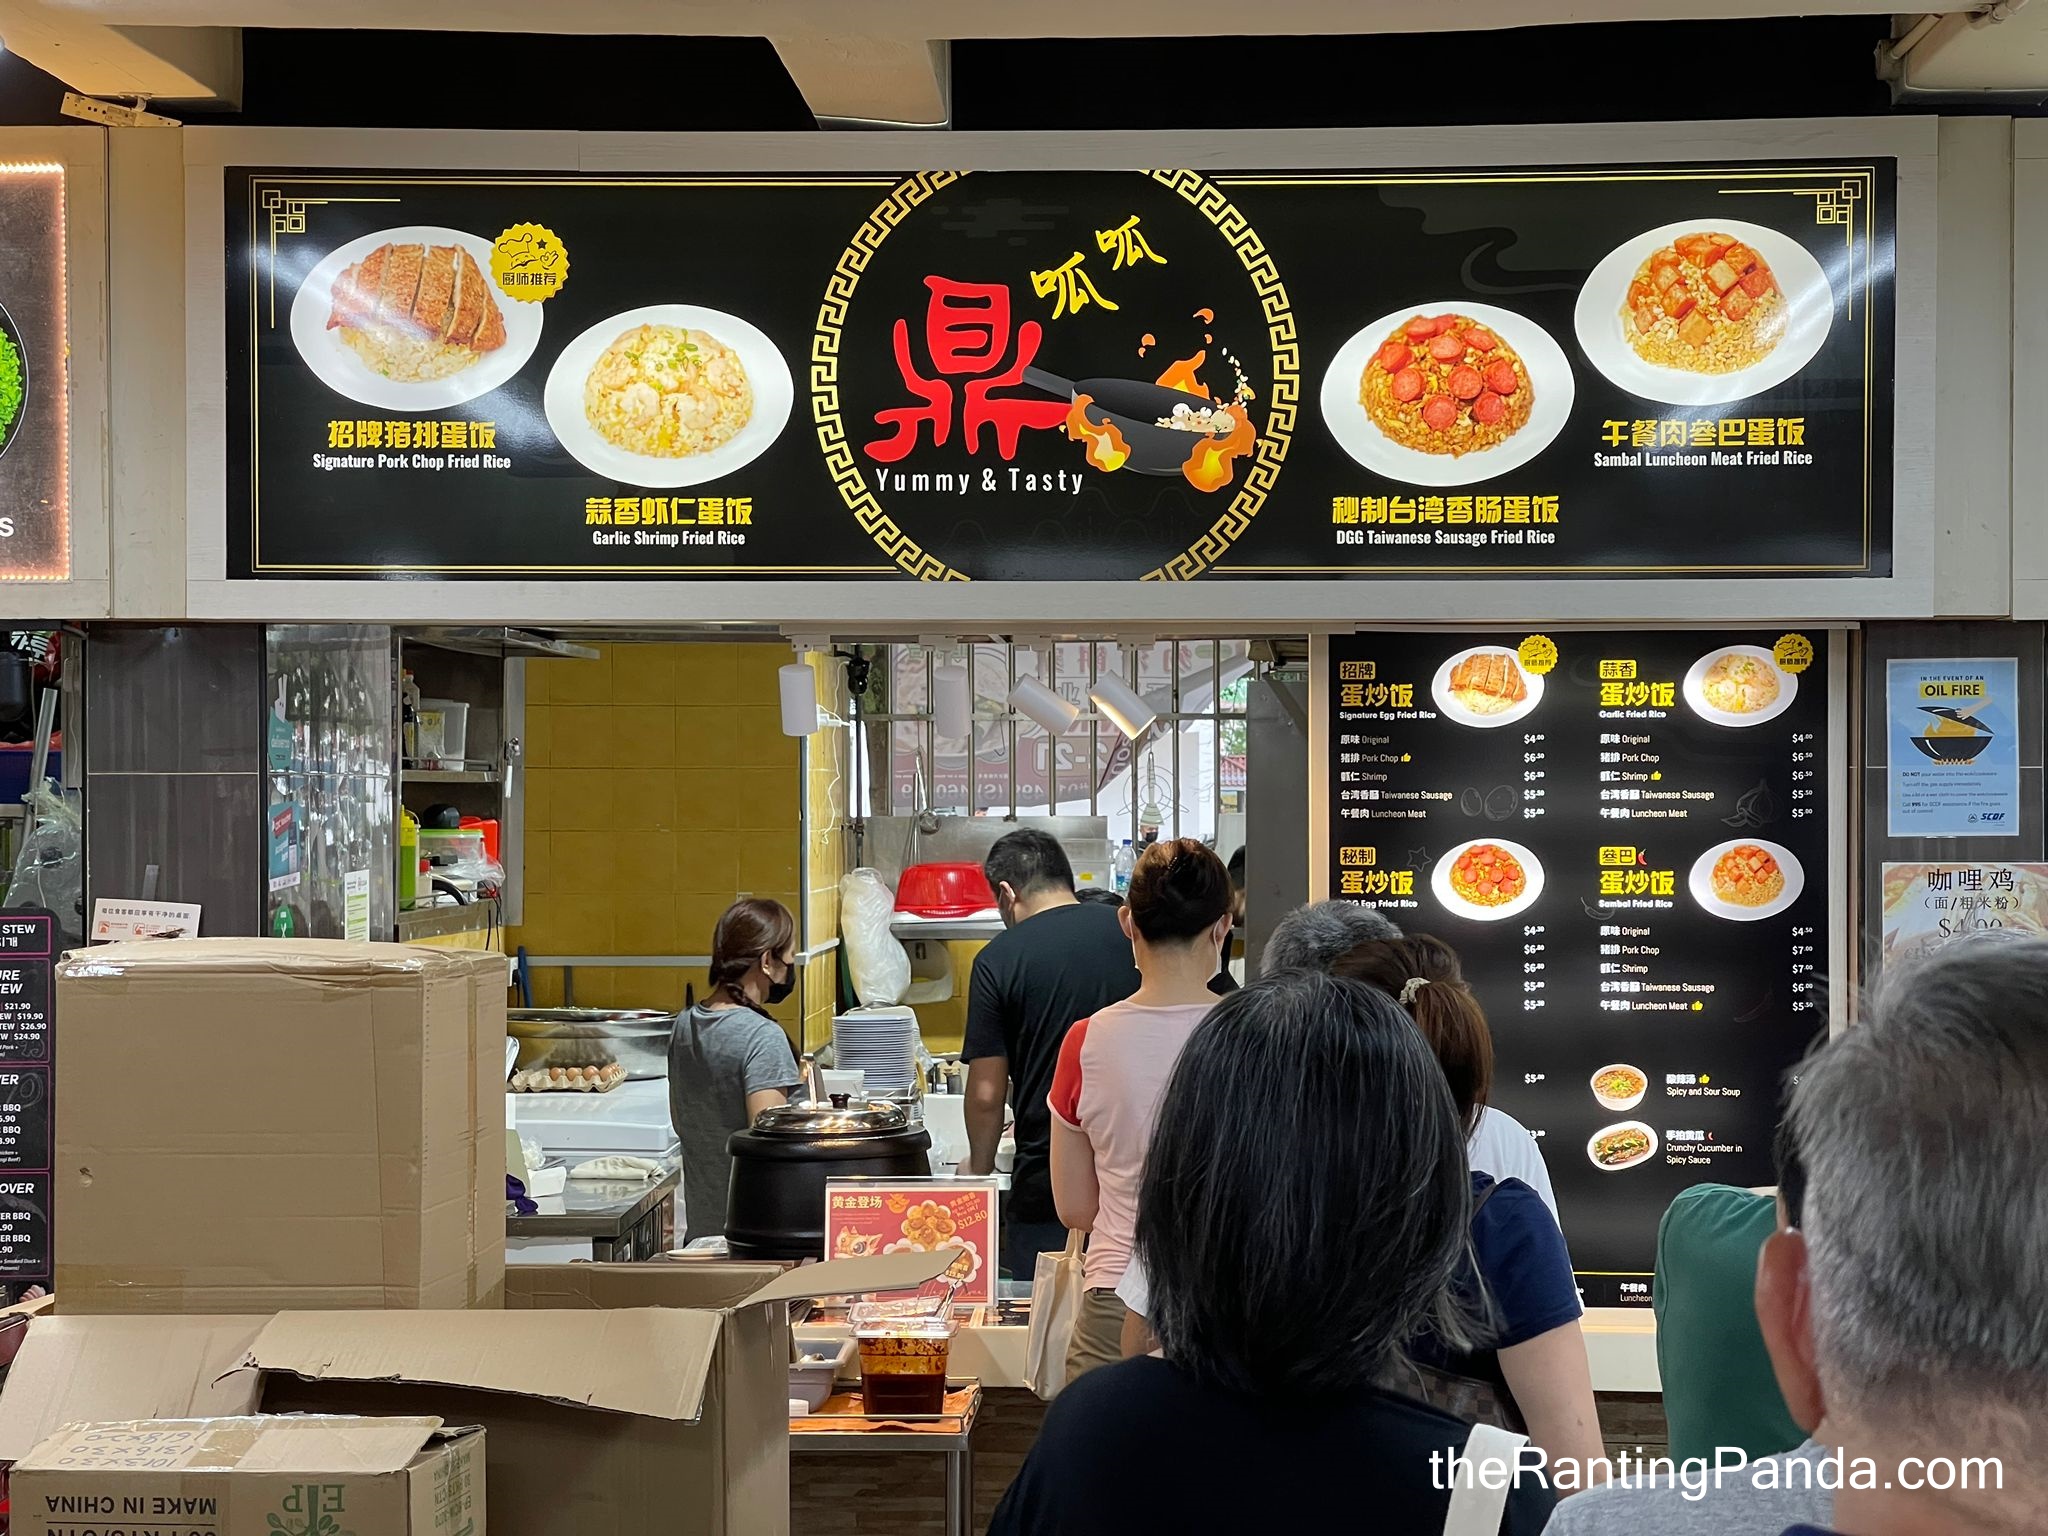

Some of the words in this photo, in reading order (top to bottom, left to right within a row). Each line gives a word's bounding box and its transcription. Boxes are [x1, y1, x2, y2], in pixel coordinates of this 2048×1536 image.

[502, 272, 557, 287] 厨师推荐
[328, 420, 496, 448] 招牌猪排蛋饭
[313, 454, 374, 471] Signature
[378, 454, 408, 468] Pork
[412, 454, 444, 471] Chop
[448, 453, 479, 468] Fried
[483, 453, 511, 468] Rice
[1594, 453, 1641, 466] Sambal
[1646, 452, 1707, 466] Luncheon
[1711, 452, 1743, 465] Meat
[1747, 451, 1779, 465] Fried
[1783, 451, 1812, 464] Rice
[876, 468, 970, 495] Yummy
[982, 468, 997, 492] &
[1008, 467, 1083, 495] Tasty
[585, 497, 752, 525] 蒜香虾仁蛋饭
[1332, 496, 1559, 524] 秘制台湾香肠蛋饭
[593, 531, 631, 545] Garlic
[634, 531, 679, 548] Shrimp
[683, 531, 714, 545] Fried
[717, 531, 745, 545] Rice
[1337, 531, 1363, 544] DGG
[1367, 530, 1431, 544] Taiwanese
[1435, 530, 1487, 546] Sausage
[1491, 530, 1522, 543] Fried
[1527, 530, 1555, 543] Rice
[1343, 663, 1373, 678] 招牌
[1602, 662, 1635, 677] 蒜香
[1341, 683, 1413, 707] 蛋炒饭
[1600, 682, 1675, 707] 蛋炒饭
[1925, 685, 1947, 696] OIL
[1952, 685, 1980, 696] FIRE
[1340, 711, 1377, 720] Signature
[1380, 711, 1395, 720] Egg
[1397, 711, 1417, 719] Fried
[1419, 711, 1437, 719] Rice
[1599, 710, 1624, 719] Garlic
[1626, 710, 1647, 719] Fried
[1649, 710, 1666, 719] Rice
[1362, 735, 1390, 746] Original
[1622, 734, 1650, 745] Original
[1362, 754, 1378, 763] Pork
[1380, 753, 1399, 764] Chop
[1622, 753, 1638, 763] Pork
[1640, 753, 1659, 764] Chop
[1362, 772, 1388, 782] Shrimp
[1622, 771, 1648, 782] Shrimp
[1381, 790, 1419, 800] Taiwanese
[1421, 790, 1453, 801] Sausage
[1641, 790, 1680, 799] Taiwanese
[1682, 790, 1714, 801] Sausage
[1371, 809, 1406, 819] Luncheon
[1408, 809, 1426, 819] Meat
[1632, 809, 1667, 818] Luncheon
[1668, 809, 1687, 818] Meat
[1342, 848, 1374, 864] 秘制
[1340, 870, 1414, 895] 蛋炒饭
[1600, 870, 1675, 895] 蛋炒饭
[1928, 868, 2013, 891] 咖哩鸡
[1361, 900, 1376, 909] Egg
[1599, 900, 1631, 908] Sambal
[1632, 900, 1653, 908] Fried
[1655, 900, 1673, 908] Rice
[2, 924, 36, 934] STEW
[1622, 927, 1650, 937] Original
[1622, 945, 1638, 955] Pork
[1640, 945, 1660, 956] Chop
[1622, 964, 1648, 975] Shrimp
[1641, 982, 1681, 992] Taiwanese
[1682, 982, 1715, 993] Sausage
[5, 1002, 31, 1010] $21.90
[1632, 1001, 1667, 1011] Luncheon
[1668, 1001, 1688, 1011] Meat
[20, 1023, 47, 1031] $26.90
[14, 1033, 40, 1041] $24.90
[1666, 1086, 1687, 1098] Spicy
[1688, 1087, 1702, 1096] and
[1703, 1087, 1720, 1096] Sour
[1722, 1087, 1741, 1098] Soup
[3, 1104, 21, 1112] BBQ
[3, 1126, 21, 1134] BBQ
[1666, 1143, 1696, 1154] Crunchy
[1698, 1143, 1733, 1153] Cucumber
[1735, 1143, 1743, 1152] in
[1666, 1155, 1687, 1166] Spicy
[1688, 1155, 1711, 1165] Sauce
[0, 1183, 34, 1193] OVER
[832, 1195, 882, 1209] 黄金登场
[13, 1213, 31, 1221] BBQ
[957, 1210, 988, 1230] $12.80
[13, 1235, 31, 1243] BBQ
[1620, 1294, 1653, 1303] Luncheon
[45, 1496, 115, 1514] CHINA
[124, 1497, 144, 1514] IN
[153, 1498, 216, 1515] MAKE
